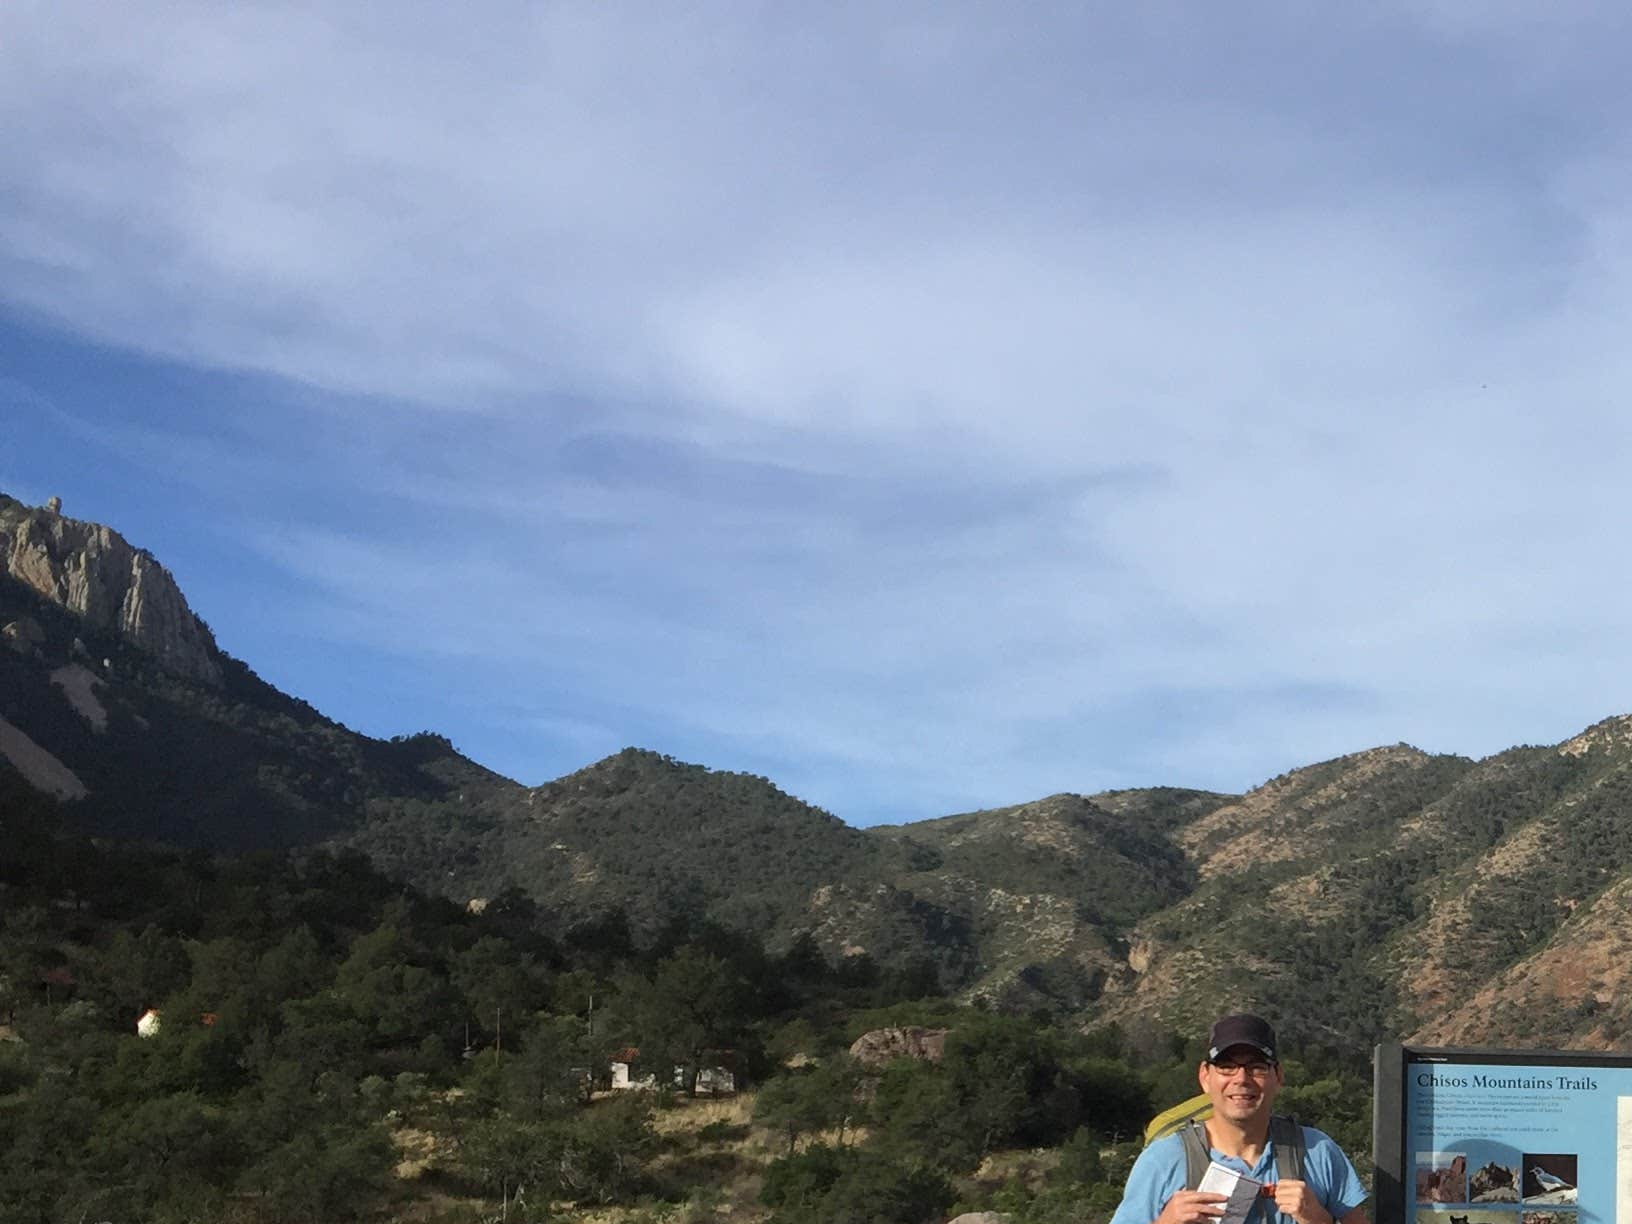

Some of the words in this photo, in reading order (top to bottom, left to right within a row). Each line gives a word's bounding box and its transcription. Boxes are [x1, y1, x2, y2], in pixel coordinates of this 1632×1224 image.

[1417, 1073, 1468, 1089] Chisos
[1472, 1075, 1553, 1091] Mountains
[1556, 1076, 1598, 1091] Trails
